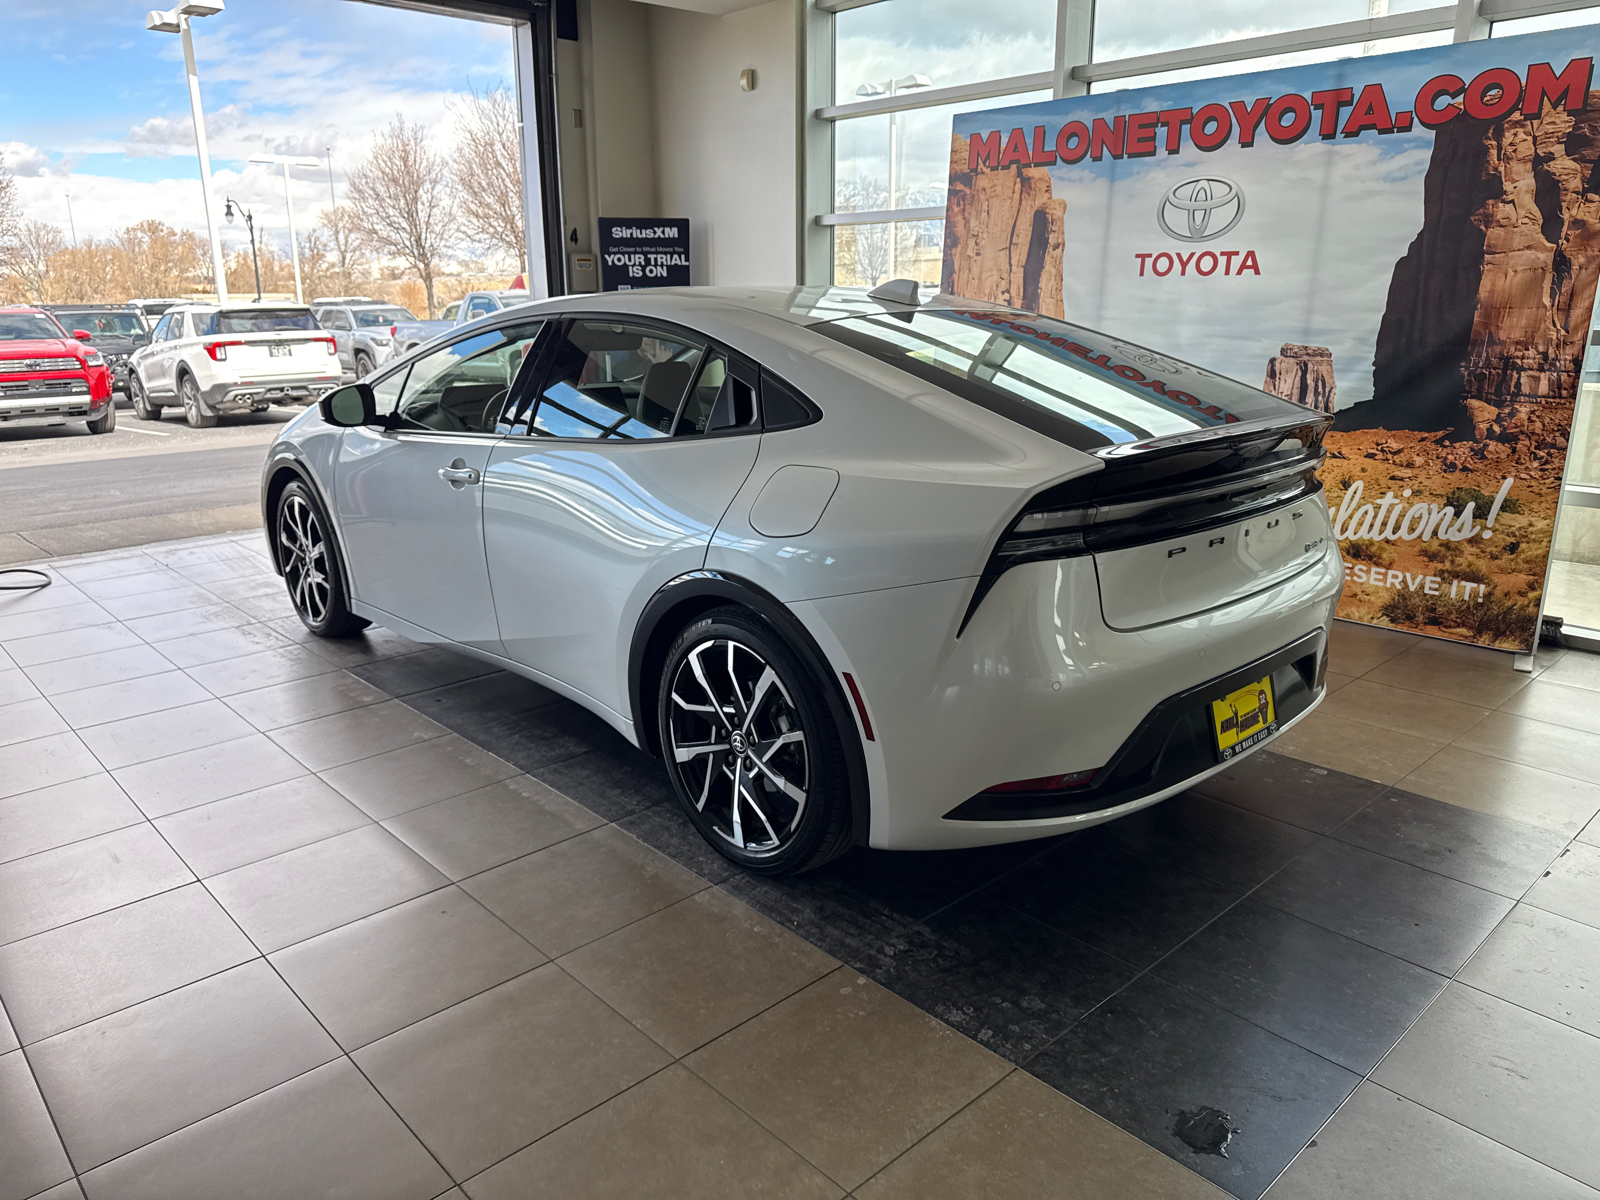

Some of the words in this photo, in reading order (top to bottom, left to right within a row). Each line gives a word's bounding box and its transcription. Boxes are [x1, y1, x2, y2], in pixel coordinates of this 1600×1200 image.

[968, 56, 1594, 170] MALONETOYOTA.COM
[570, 227, 579, 245] 4
[612, 227, 678, 239] SiriusXM
[604, 254, 645, 266] YOUR
[648, 254, 689, 266] TRIAL
[628, 266, 643, 278] IS
[645, 266, 668, 278] ON
[1134, 249, 1262, 278] TOYOTA
[1329, 477, 1514, 542] lations!
[1167, 508, 1304, 559] PRIUS
[1344, 562, 1442, 597] ESERVE
[1450, 579, 1486, 603] IT!
[1260, 694, 1266, 704] 32
[1235, 744, 1242, 753] WE
[1242, 738, 1253, 749] MAKE
[1258, 729, 1268, 740] EASY
